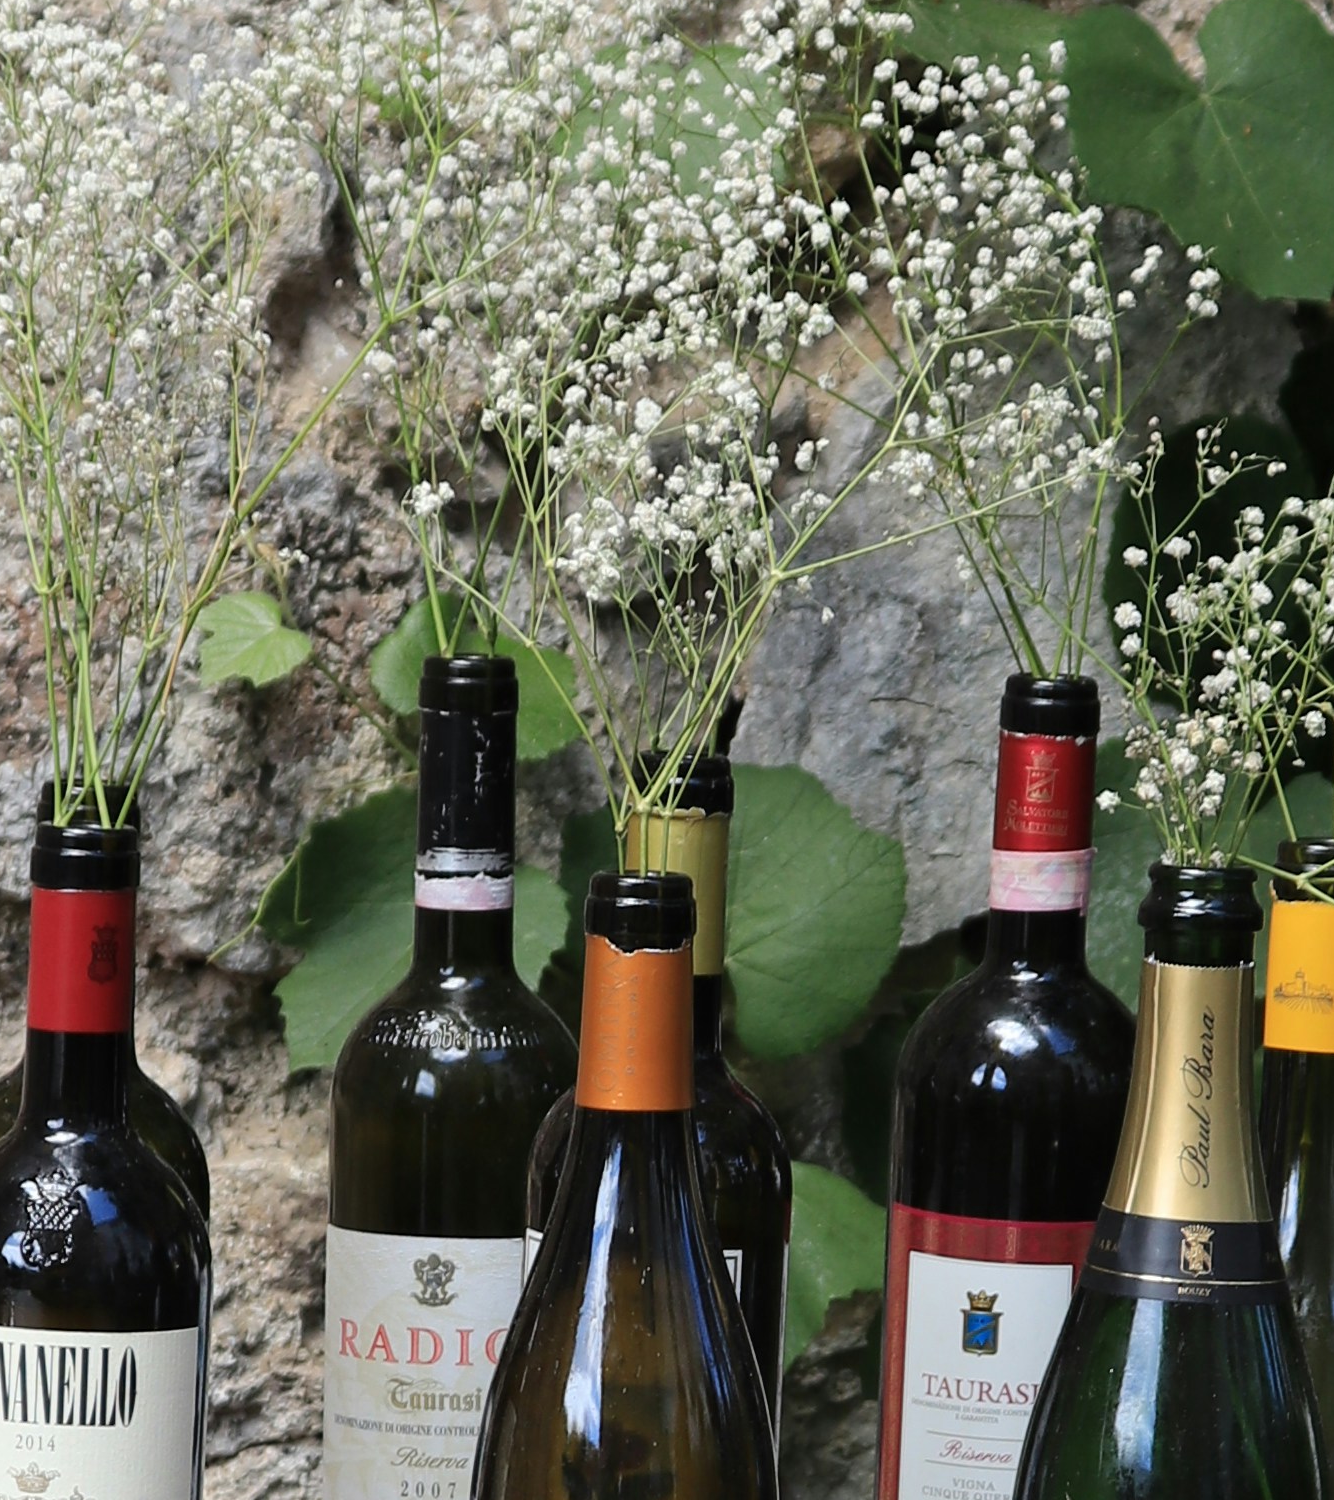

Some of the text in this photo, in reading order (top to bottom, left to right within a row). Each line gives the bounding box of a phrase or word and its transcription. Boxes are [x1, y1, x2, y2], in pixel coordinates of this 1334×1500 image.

[1178, 1004, 1216, 1189] Paul Bara
[385, 1374, 483, 1414] Taurasi
[385, 1423, 394, 1433] DI
[396, 1424, 432, 1436] ORIGINE
[14, 1434, 57, 1451] 2014
[939, 1439, 1013, 1464] Riserva
[390, 1446, 469, 1470] Riserva
[400, 1480, 456, 1500] 2007
[922, 1485, 969, 1500] CINQUE
[952, 1477, 995, 1492] VIGNA
